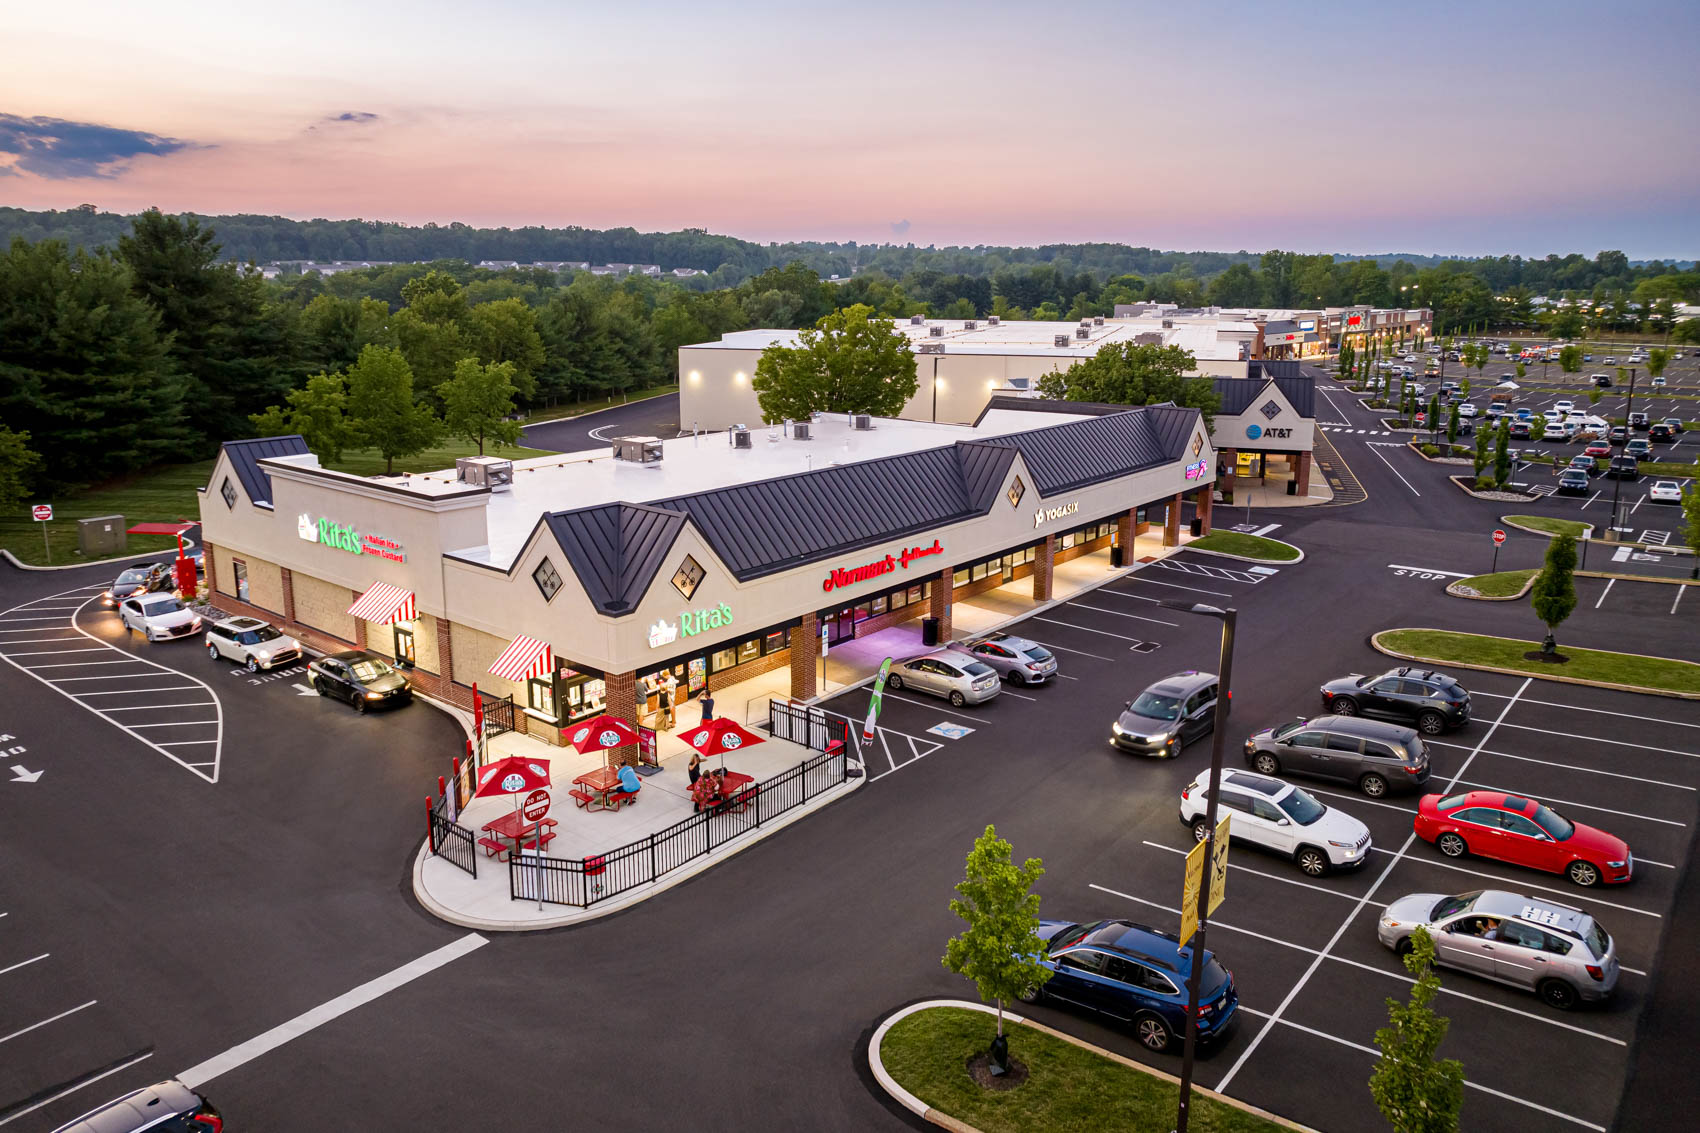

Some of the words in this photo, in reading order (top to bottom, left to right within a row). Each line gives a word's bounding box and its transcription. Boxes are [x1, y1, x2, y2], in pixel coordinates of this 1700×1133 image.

[1263, 427, 1293, 439] AT&T
[1045, 501, 1079, 521] YOGASIX
[318, 517, 362, 555] Rita's
[386, 539, 395, 549] Ice
[362, 544, 381, 556] Frozen
[381, 549, 404, 563] Custard
[823, 554, 897, 592] Norman's
[1394, 569, 1447, 581] STOP
[681, 601, 734, 639] Rita's
[526, 797, 535, 805] DO
[536, 792, 547, 801] NOT
[529, 807, 546, 818] ENTER
